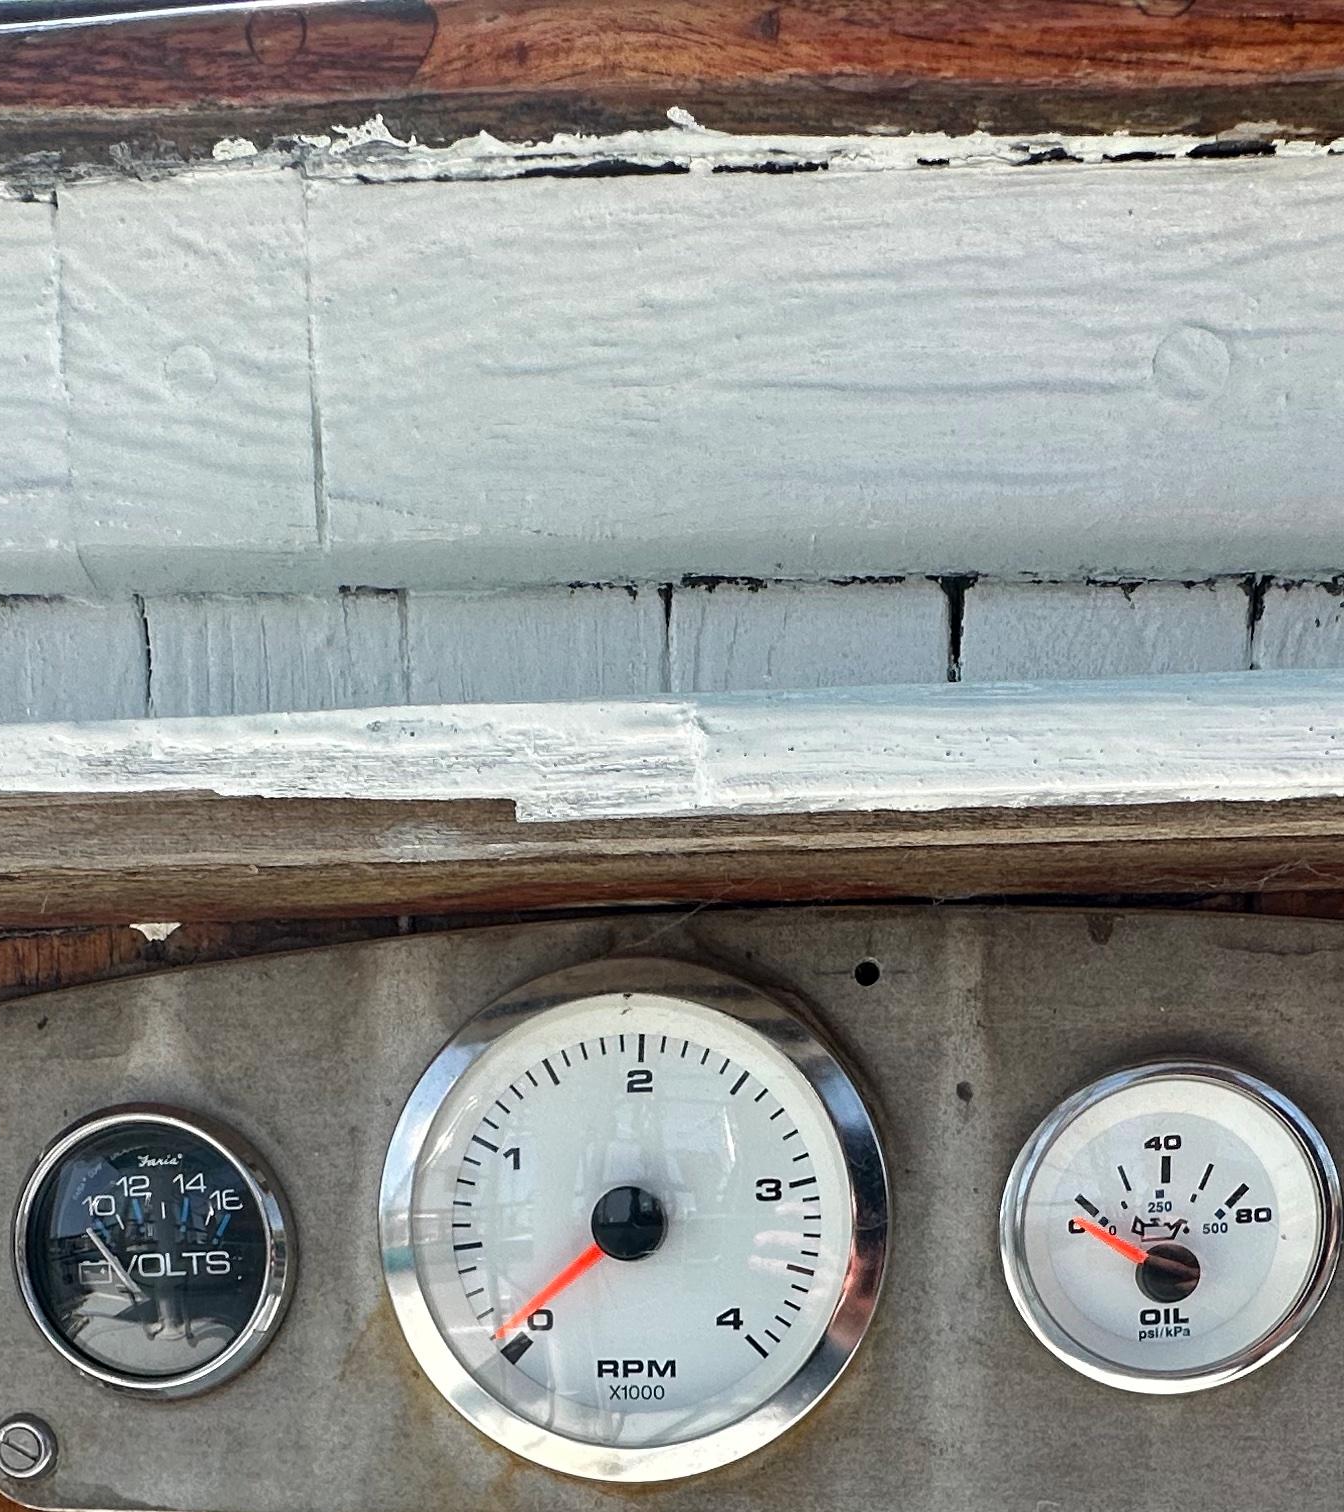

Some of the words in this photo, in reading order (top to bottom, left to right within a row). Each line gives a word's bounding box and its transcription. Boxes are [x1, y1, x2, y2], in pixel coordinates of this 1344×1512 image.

[627, 1069, 653, 1093] 2
[1144, 1134, 1182, 1150] 40
[503, 1147, 521, 1170] 1
[116, 1175, 152, 1197] 12
[172, 1172, 207, 1195] 14
[756, 1178, 782, 1201] 3
[81, 1195, 116, 1216] 10
[1147, 1201, 1172, 1213] 250
[1235, 1207, 1272, 1224] 80
[1108, 1225, 1117, 1236] 0
[1202, 1222, 1228, 1235] 500
[116, 1251, 232, 1278] VOLTS
[527, 1308, 554, 1331] 0
[716, 1307, 744, 1330] 4
[1140, 1308, 1190, 1326] OIL
[597, 1360, 676, 1378] RPM
[609, 1384, 665, 1401] X1000
